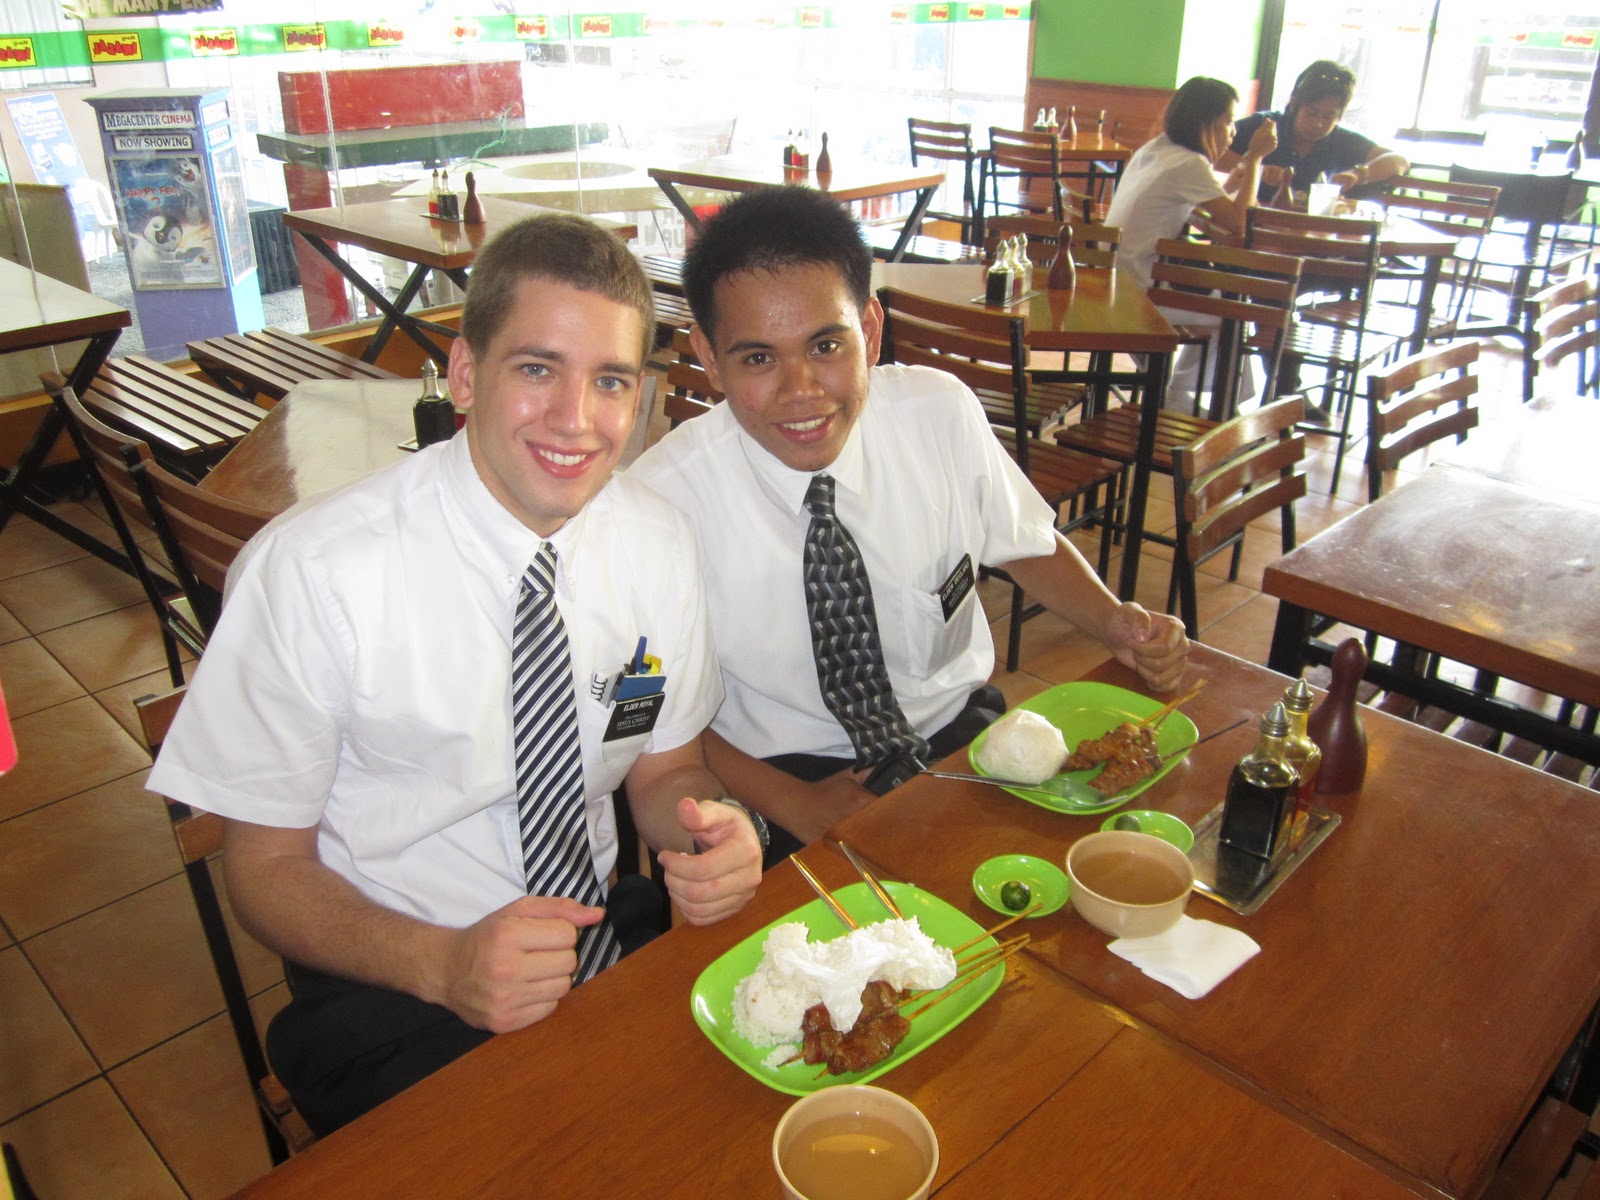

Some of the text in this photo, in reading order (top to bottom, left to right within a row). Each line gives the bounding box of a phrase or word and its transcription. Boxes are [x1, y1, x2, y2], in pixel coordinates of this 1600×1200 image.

[104, 113, 193, 127] MEGACENTER CINEMA
[119, 136, 189, 148] NOW SHOWING
[942, 583, 954, 601] ELDER
[623, 702, 639, 712] ELDER
